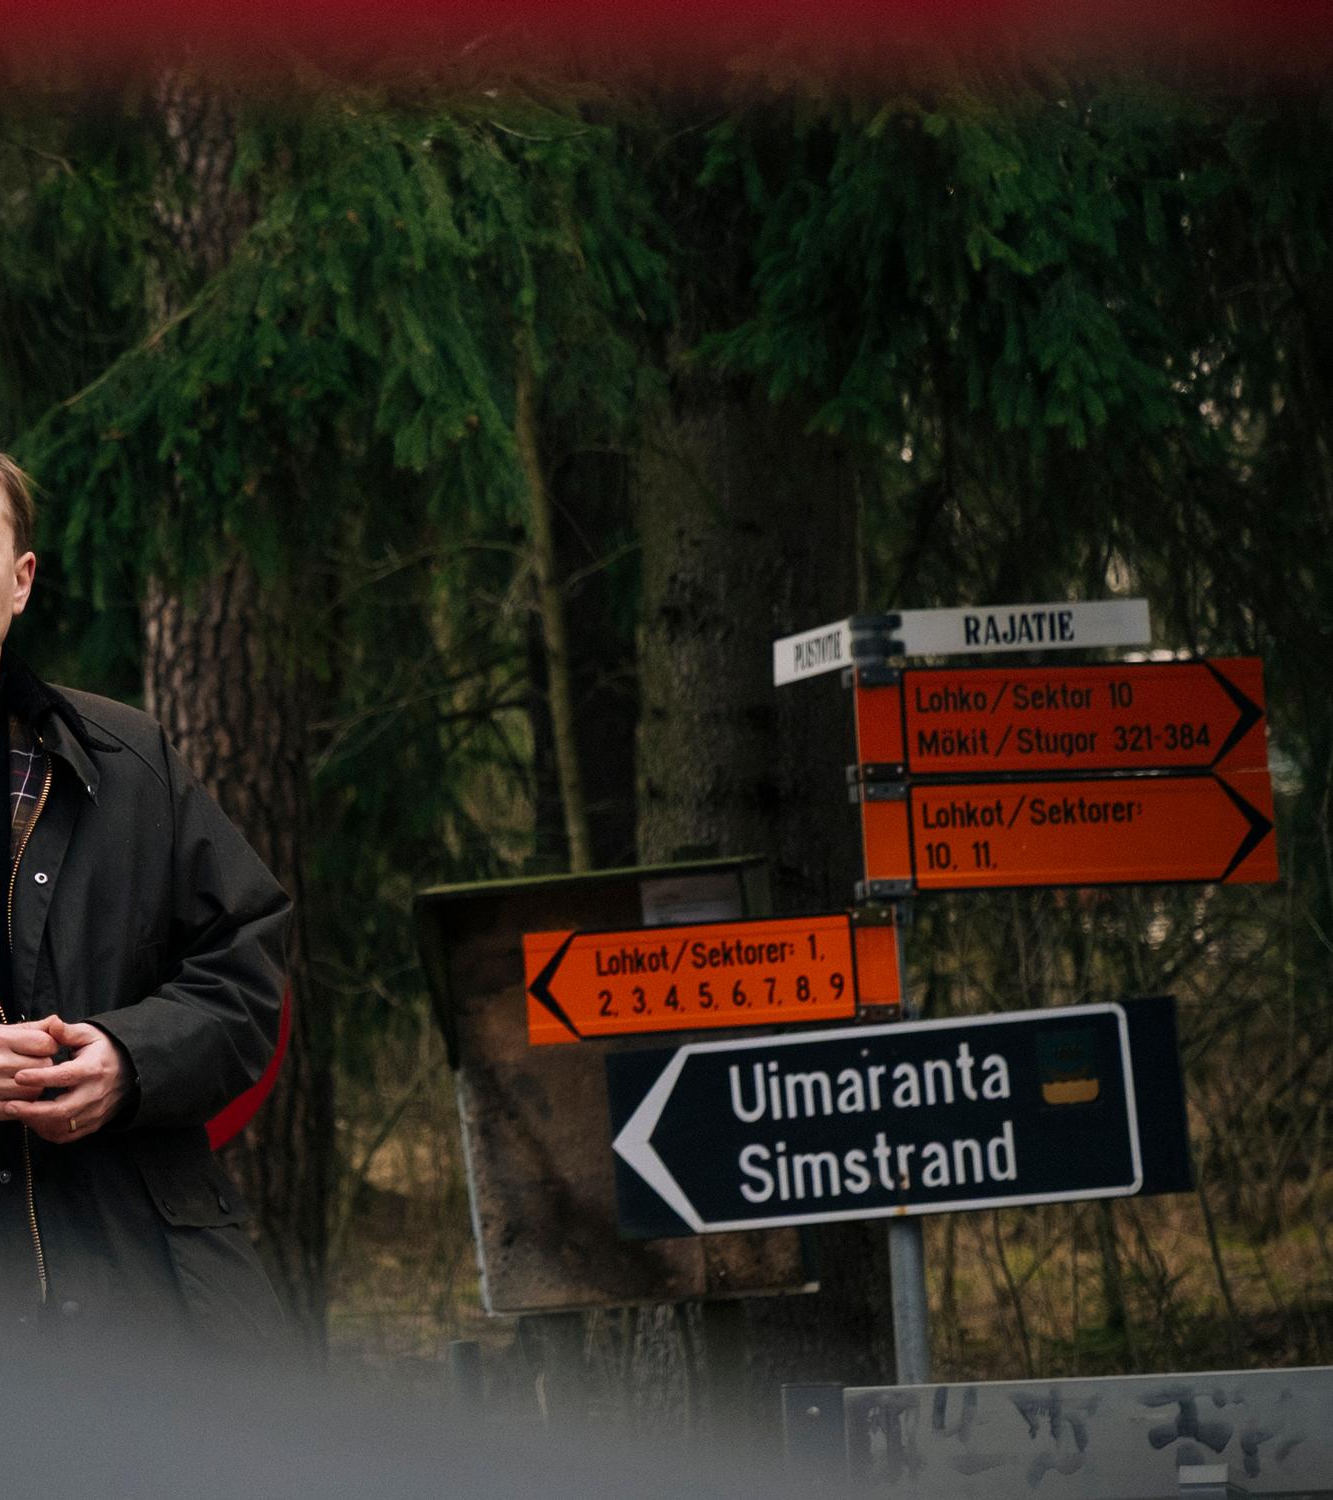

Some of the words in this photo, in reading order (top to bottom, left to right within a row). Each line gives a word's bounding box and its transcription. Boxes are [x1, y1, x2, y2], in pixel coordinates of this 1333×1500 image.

[963, 609, 1075, 645] RAJATIE
[1109, 682, 1133, 709] 10
[1114, 723, 1210, 751] 321-384
[830, 972, 845, 1000] 9
[728, 1041, 1011, 1124] Uimaranta
[738, 1120, 1018, 1203] Simstrand
